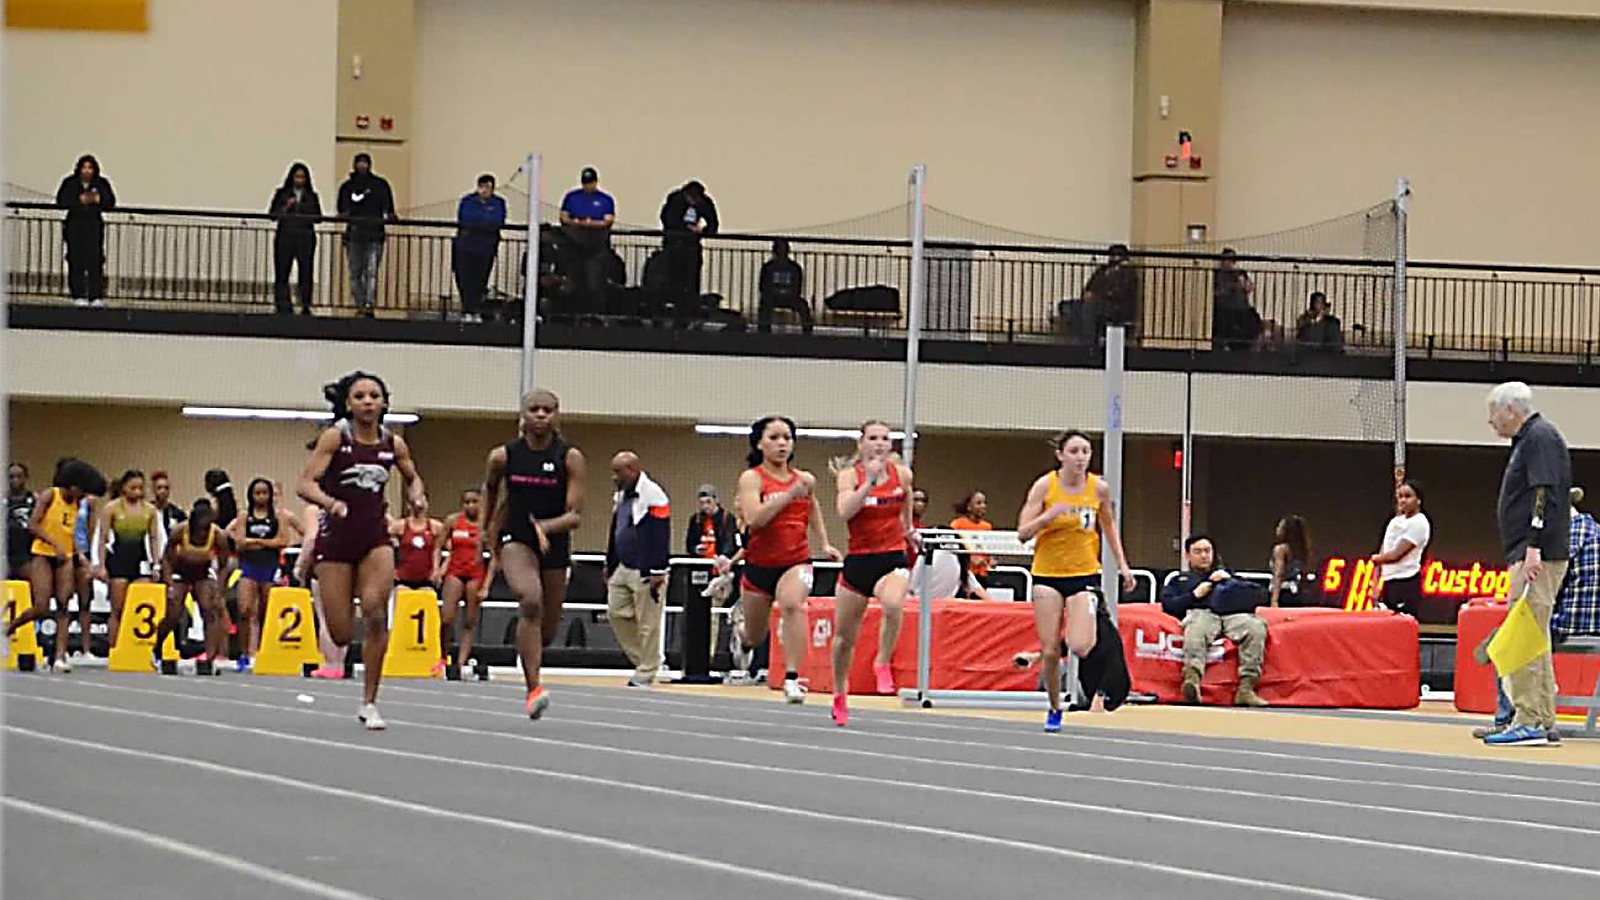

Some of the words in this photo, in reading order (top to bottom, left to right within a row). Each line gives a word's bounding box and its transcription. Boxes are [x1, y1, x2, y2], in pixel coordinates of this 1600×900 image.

[1325, 559, 1345, 590] 5
[134, 604, 156, 639] 3
[279, 607, 302, 642] 2
[410, 609, 425, 644] 1
